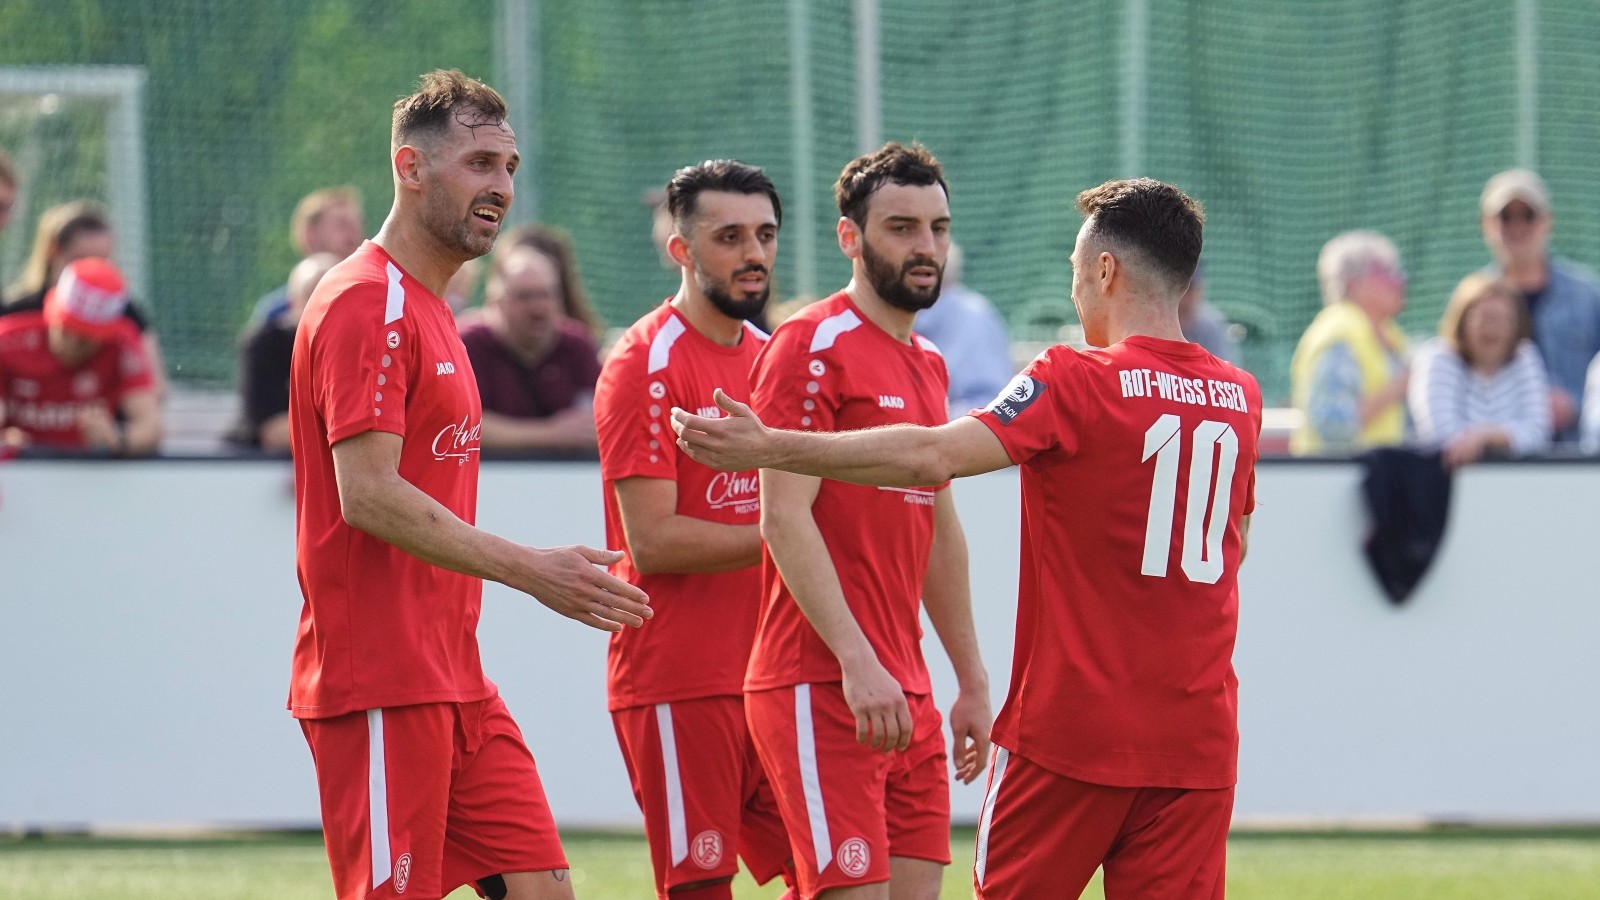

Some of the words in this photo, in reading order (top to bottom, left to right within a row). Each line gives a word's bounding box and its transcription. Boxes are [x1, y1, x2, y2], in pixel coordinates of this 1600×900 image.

[436, 361, 455, 376] JAKO
[878, 394, 905, 410] JAKO
[1118, 368, 1207, 406] ROT-WEISS
[1208, 379, 1249, 414] ESSEN
[1140, 413, 1239, 585] 10
